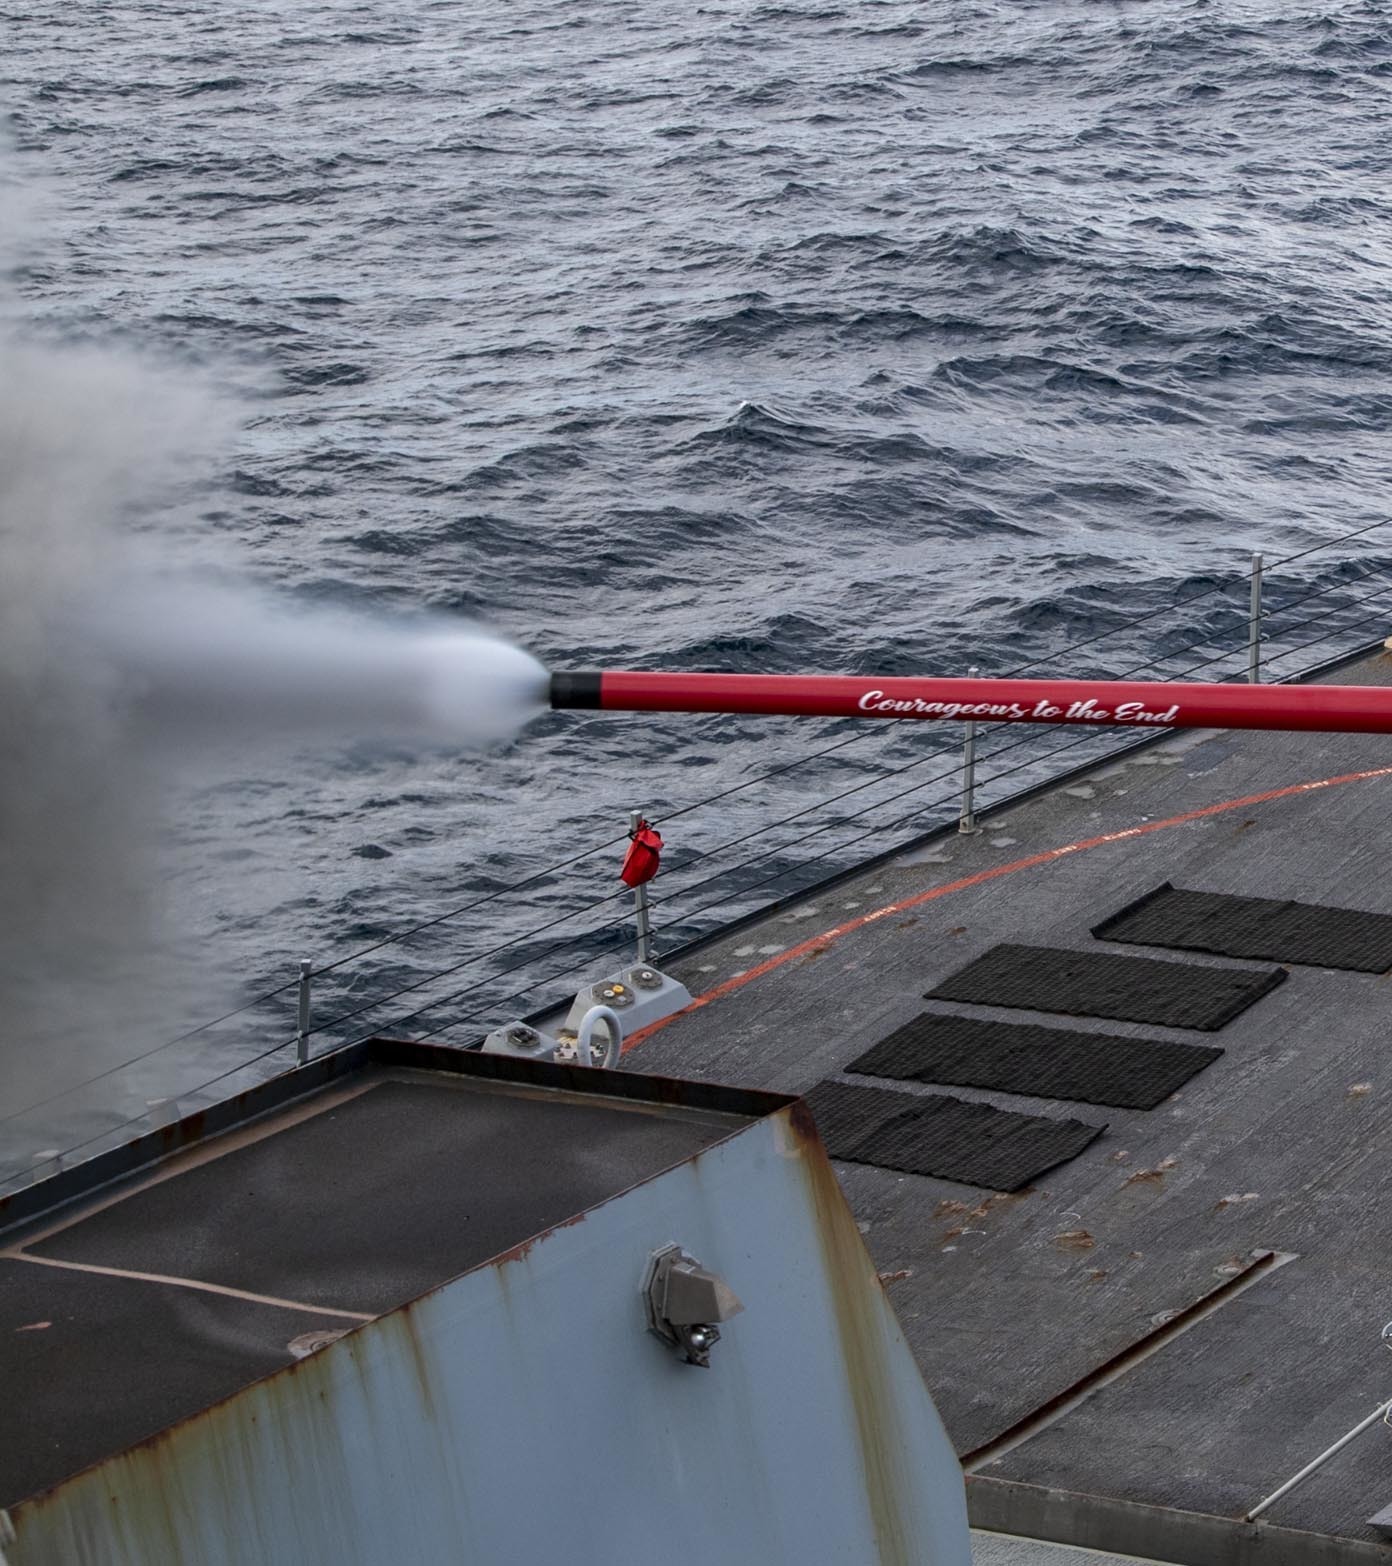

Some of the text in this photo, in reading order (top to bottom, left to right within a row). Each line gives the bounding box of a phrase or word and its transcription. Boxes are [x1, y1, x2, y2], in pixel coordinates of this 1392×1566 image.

[858, 690, 1180, 722] Courageous to the End
